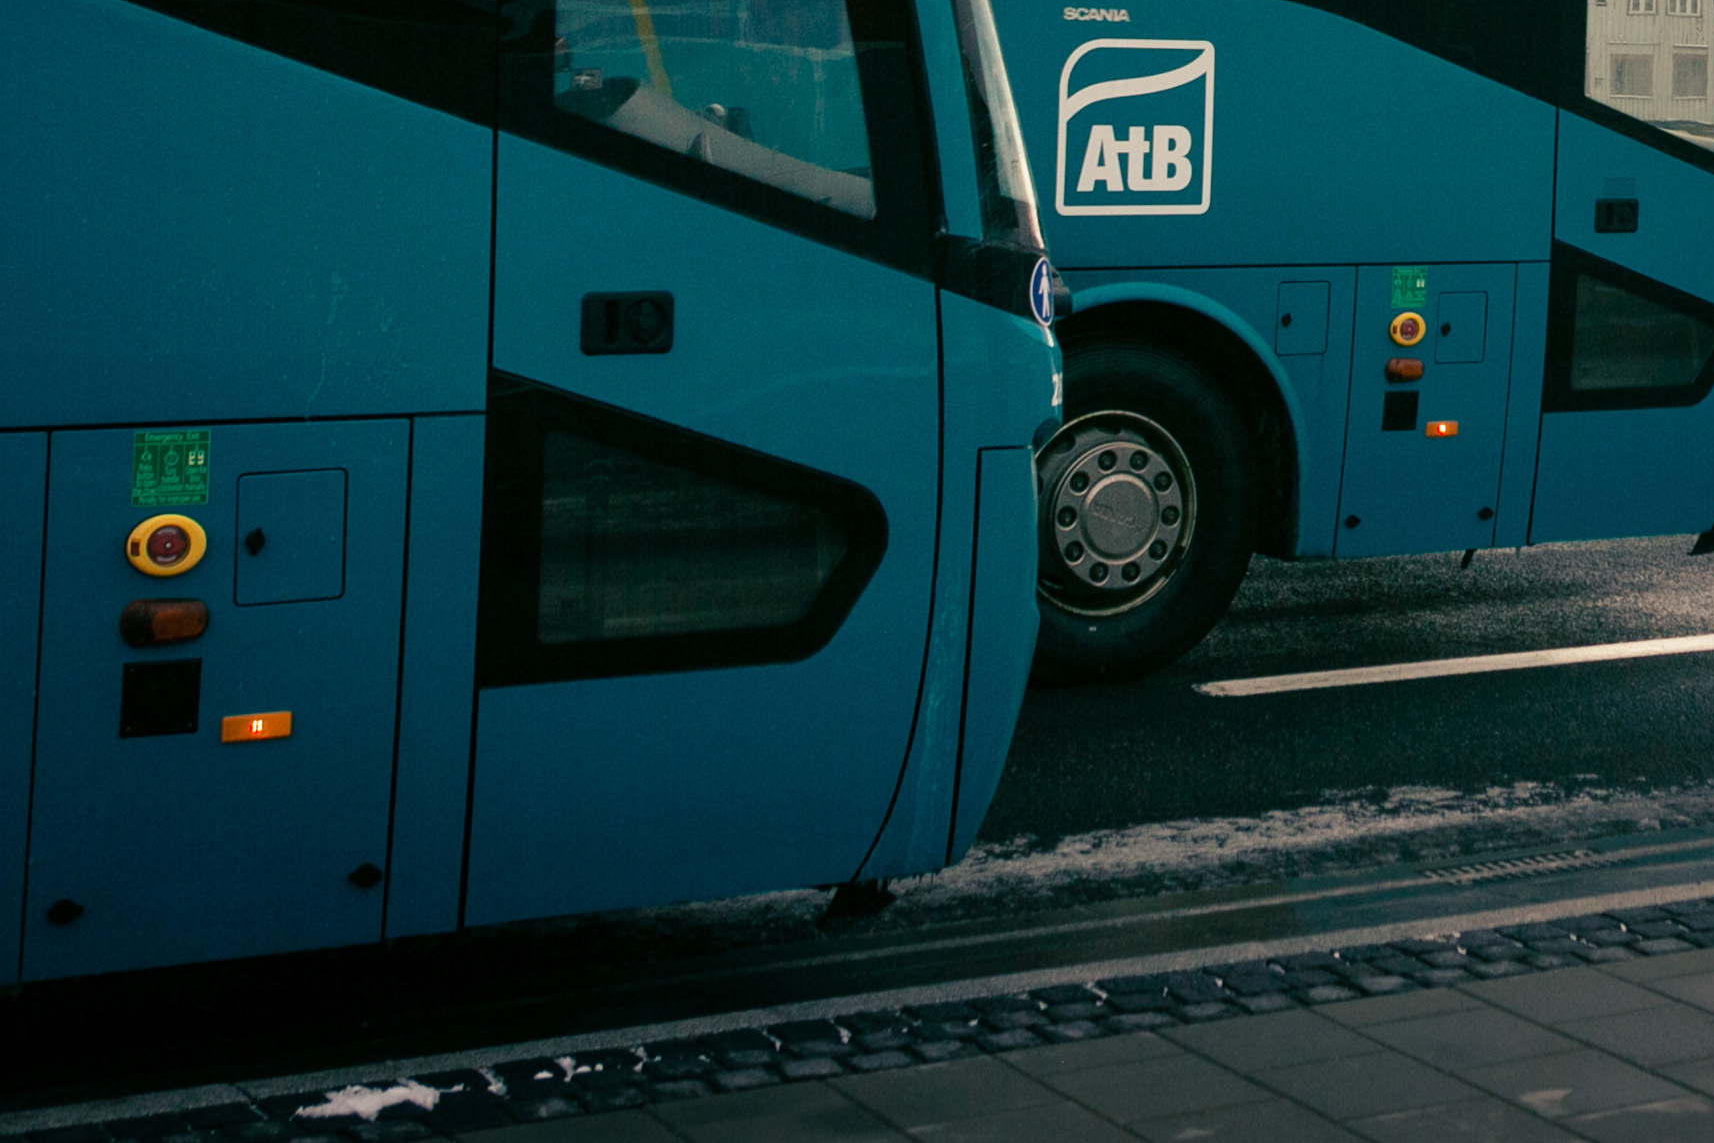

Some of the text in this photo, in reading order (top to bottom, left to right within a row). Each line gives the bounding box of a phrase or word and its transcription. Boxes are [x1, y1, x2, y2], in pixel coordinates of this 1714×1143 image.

[1063, 6, 1130, 22] SCANIA
[1077, 125, 1193, 192] AtB
[145, 432, 184, 445] Emergency
